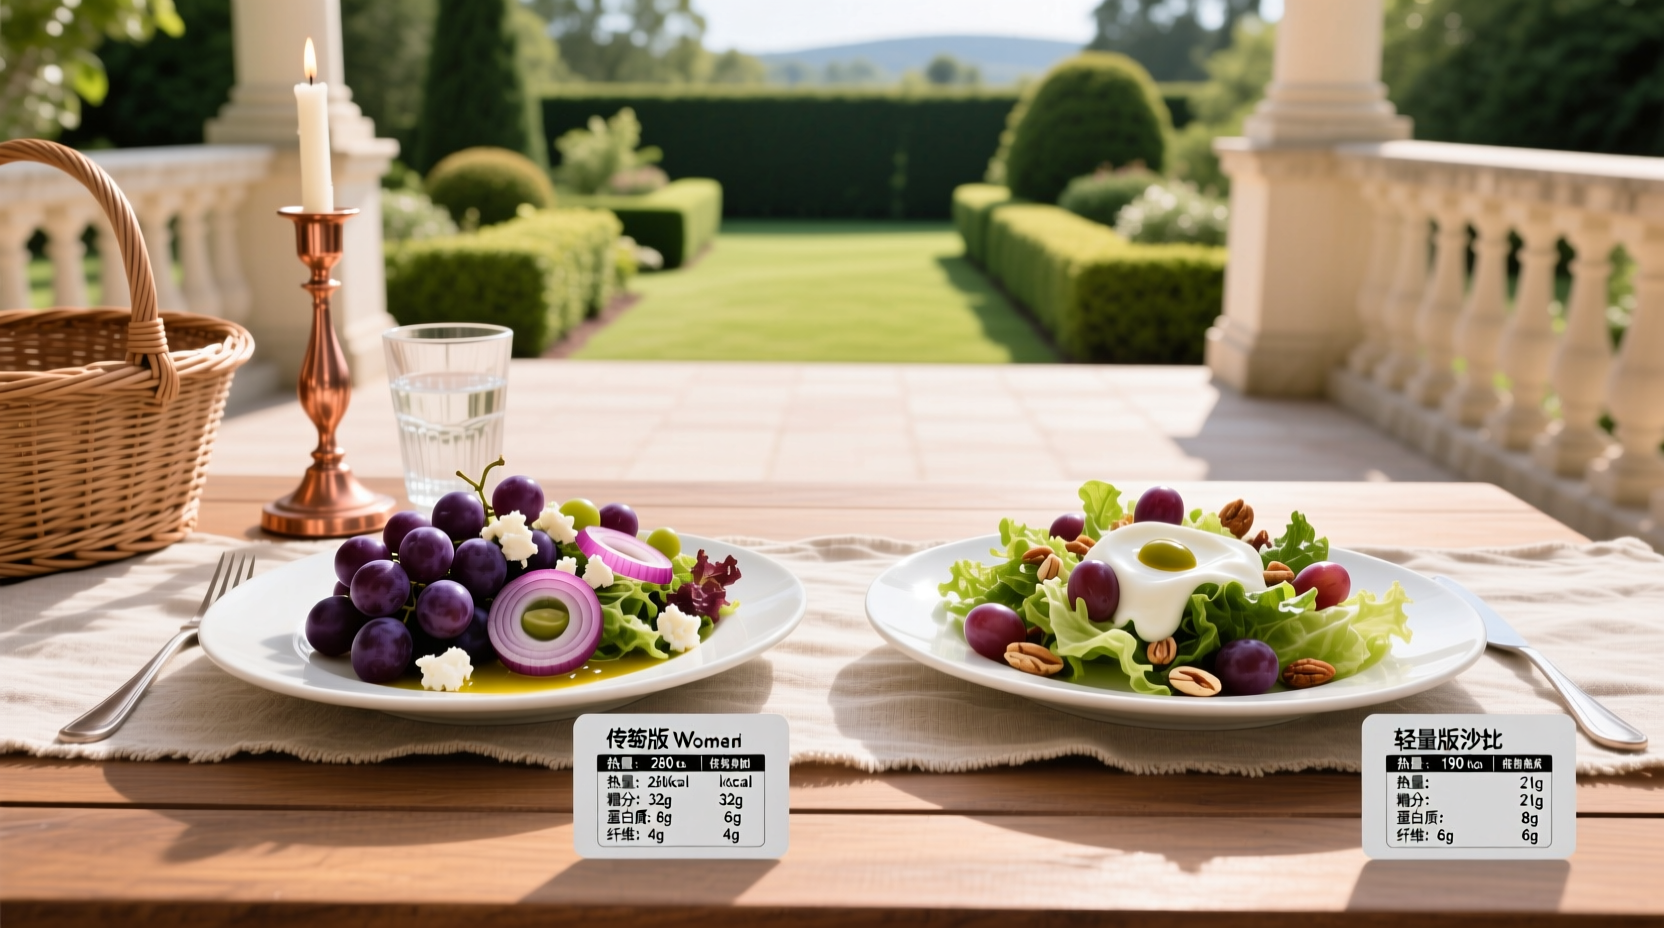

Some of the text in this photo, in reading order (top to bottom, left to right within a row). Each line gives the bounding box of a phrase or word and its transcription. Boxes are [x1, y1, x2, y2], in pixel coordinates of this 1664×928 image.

[651, 756, 674, 769] 280
[1442, 756, 1464, 770] 190
[648, 793, 672, 809] 32g
[718, 793, 743, 809] 32g
[656, 811, 672, 826] 6g
[724, 811, 742, 826] 6g
[1521, 811, 1539, 827] 8g
[647, 828, 664, 844] 4g
[723, 828, 740, 844] 4g
[1437, 829, 1454, 844] 6g
[1521, 829, 1539, 845] 6g
